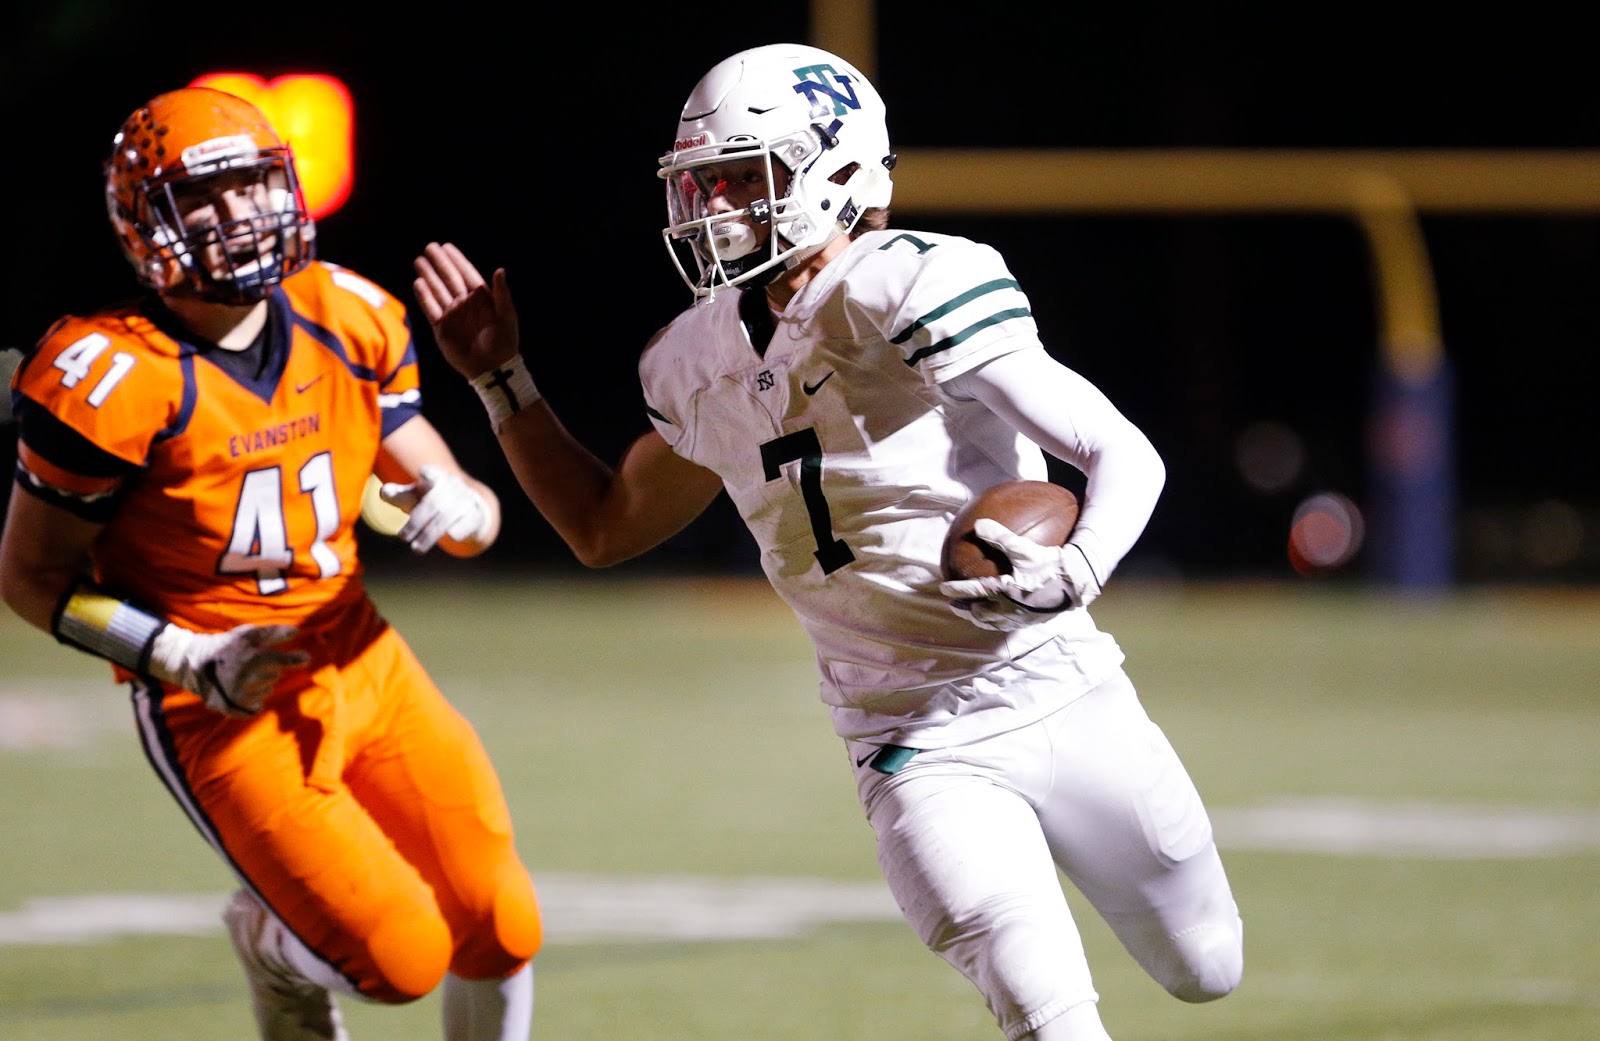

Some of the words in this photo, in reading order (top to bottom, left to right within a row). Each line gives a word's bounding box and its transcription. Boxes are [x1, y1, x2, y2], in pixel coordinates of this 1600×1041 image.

[675, 134, 706, 152] Riddell
[878, 233, 938, 255] 7
[52, 331, 137, 410] 41
[229, 414, 320, 458] EVANSTON
[215, 450, 342, 596] 41
[760, 427, 856, 576] 7
